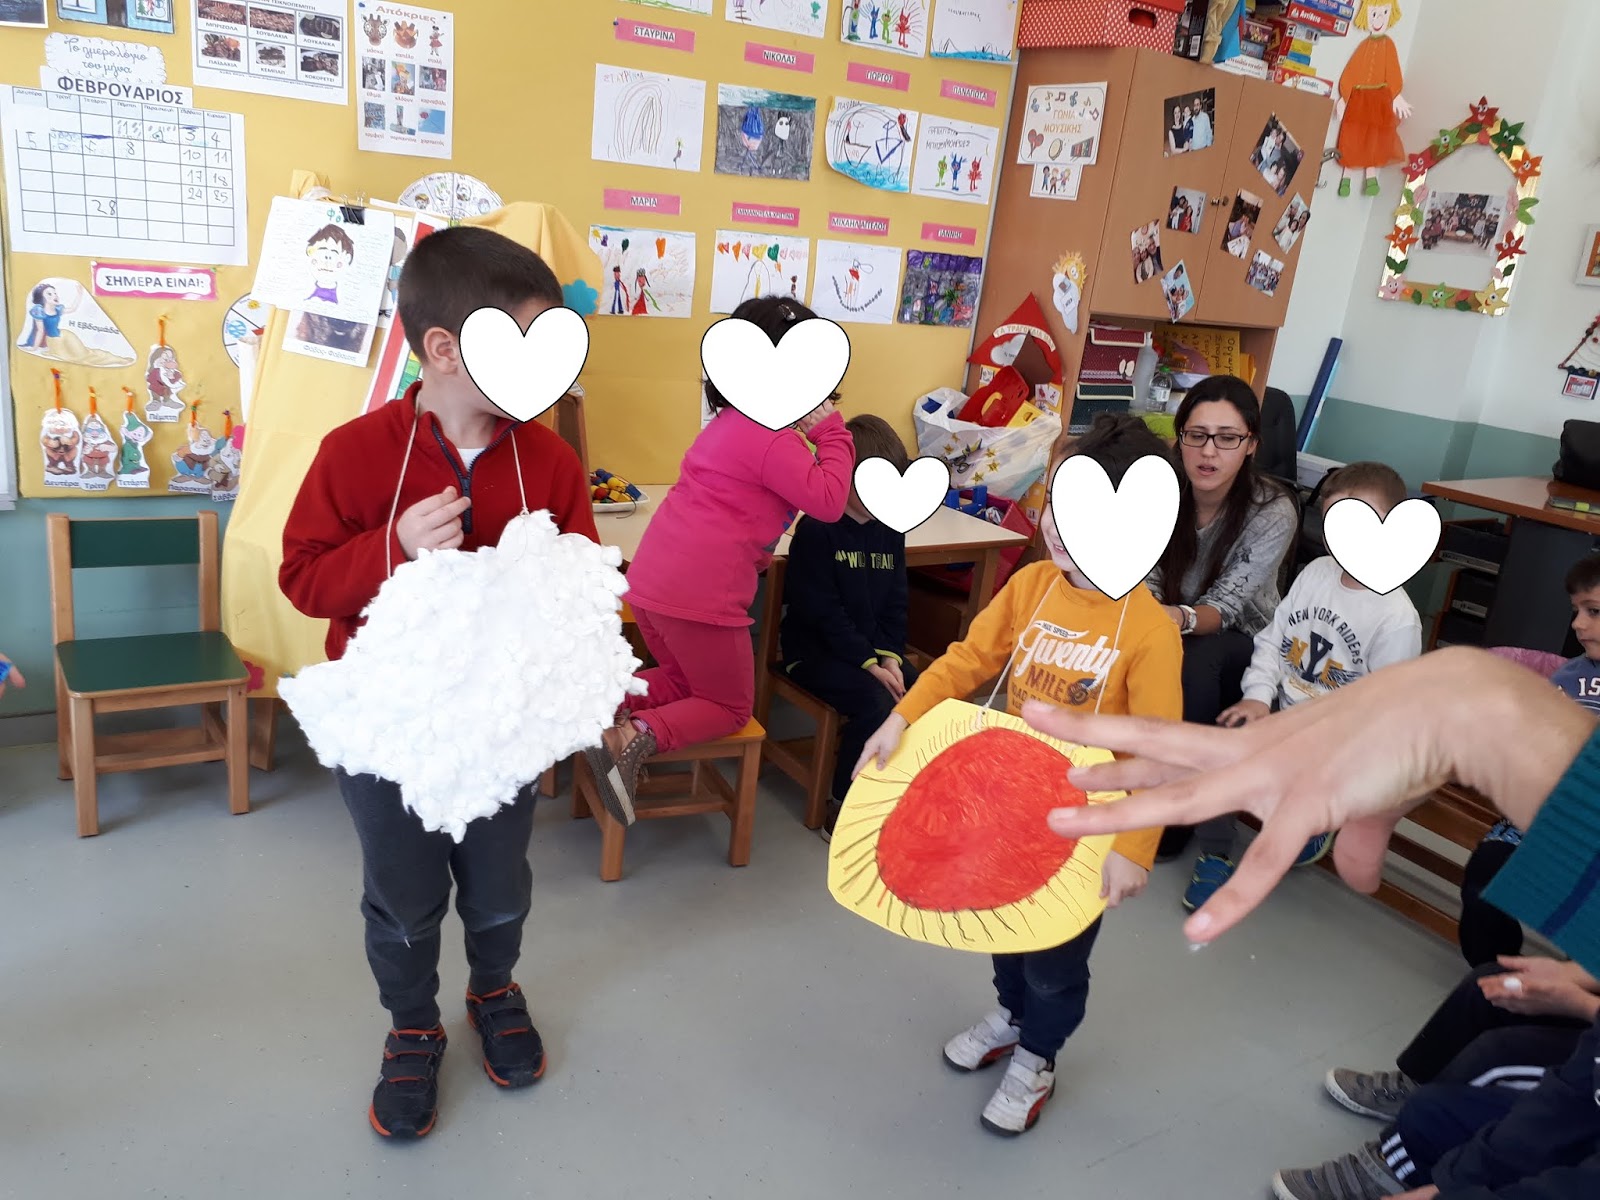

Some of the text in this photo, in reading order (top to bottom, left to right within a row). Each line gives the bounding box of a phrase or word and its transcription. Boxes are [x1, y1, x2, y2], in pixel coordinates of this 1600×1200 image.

[376, 6, 437, 24] Απόκριες
[205, 22, 238, 31] ΜΠΡΙΖΟΛΑ
[634, 26, 675, 41] ΣΤΑΥΡΙΝΑ
[256, 30, 288, 40] ΣΟΥΒΛΑΚΙΑ
[303, 38, 336, 47] ΛΟΥΚΑΝΙΚΑ
[763, 51, 796, 64] ΝΙΚΟΛΑΣ
[866, 70, 893, 83] ΓΙΩΡΓΟΣ
[57, 75, 184, 104] ΦΕΒΡΟΥΑΡΙΟΣ
[953, 86, 988, 100] ΠΑΝΑΓΙΩΤΑ
[1053, 109, 1075, 119] ΓΩΝΙΑ
[1043, 124, 1082, 134] ΜΟΥΣΙΚΗΣ
[210, 131, 221, 147] 4
[183, 149, 229, 163] 10 11
[187, 169, 202, 183] 17
[92, 199, 118, 216] 28
[630, 196, 657, 207] ΜΑΡΙΑ
[105, 275, 204, 289] ΣΗΜΕΡΑ ΕΙΝΑΙ:
[68, 320, 120, 335] Η Εβδομάδα
[149, 413, 178, 421] Πέμπτη
[44, 479, 211, 494] Δευτέρα Τρίτη Τετάρτη Παρασκευή
[1053, 628, 1068, 637] SPEED
[1288, 606, 1364, 665] NEW YORK RIDERS
[1014, 630, 1121, 691] Twenty
[1578, 677, 1600, 696] 15
